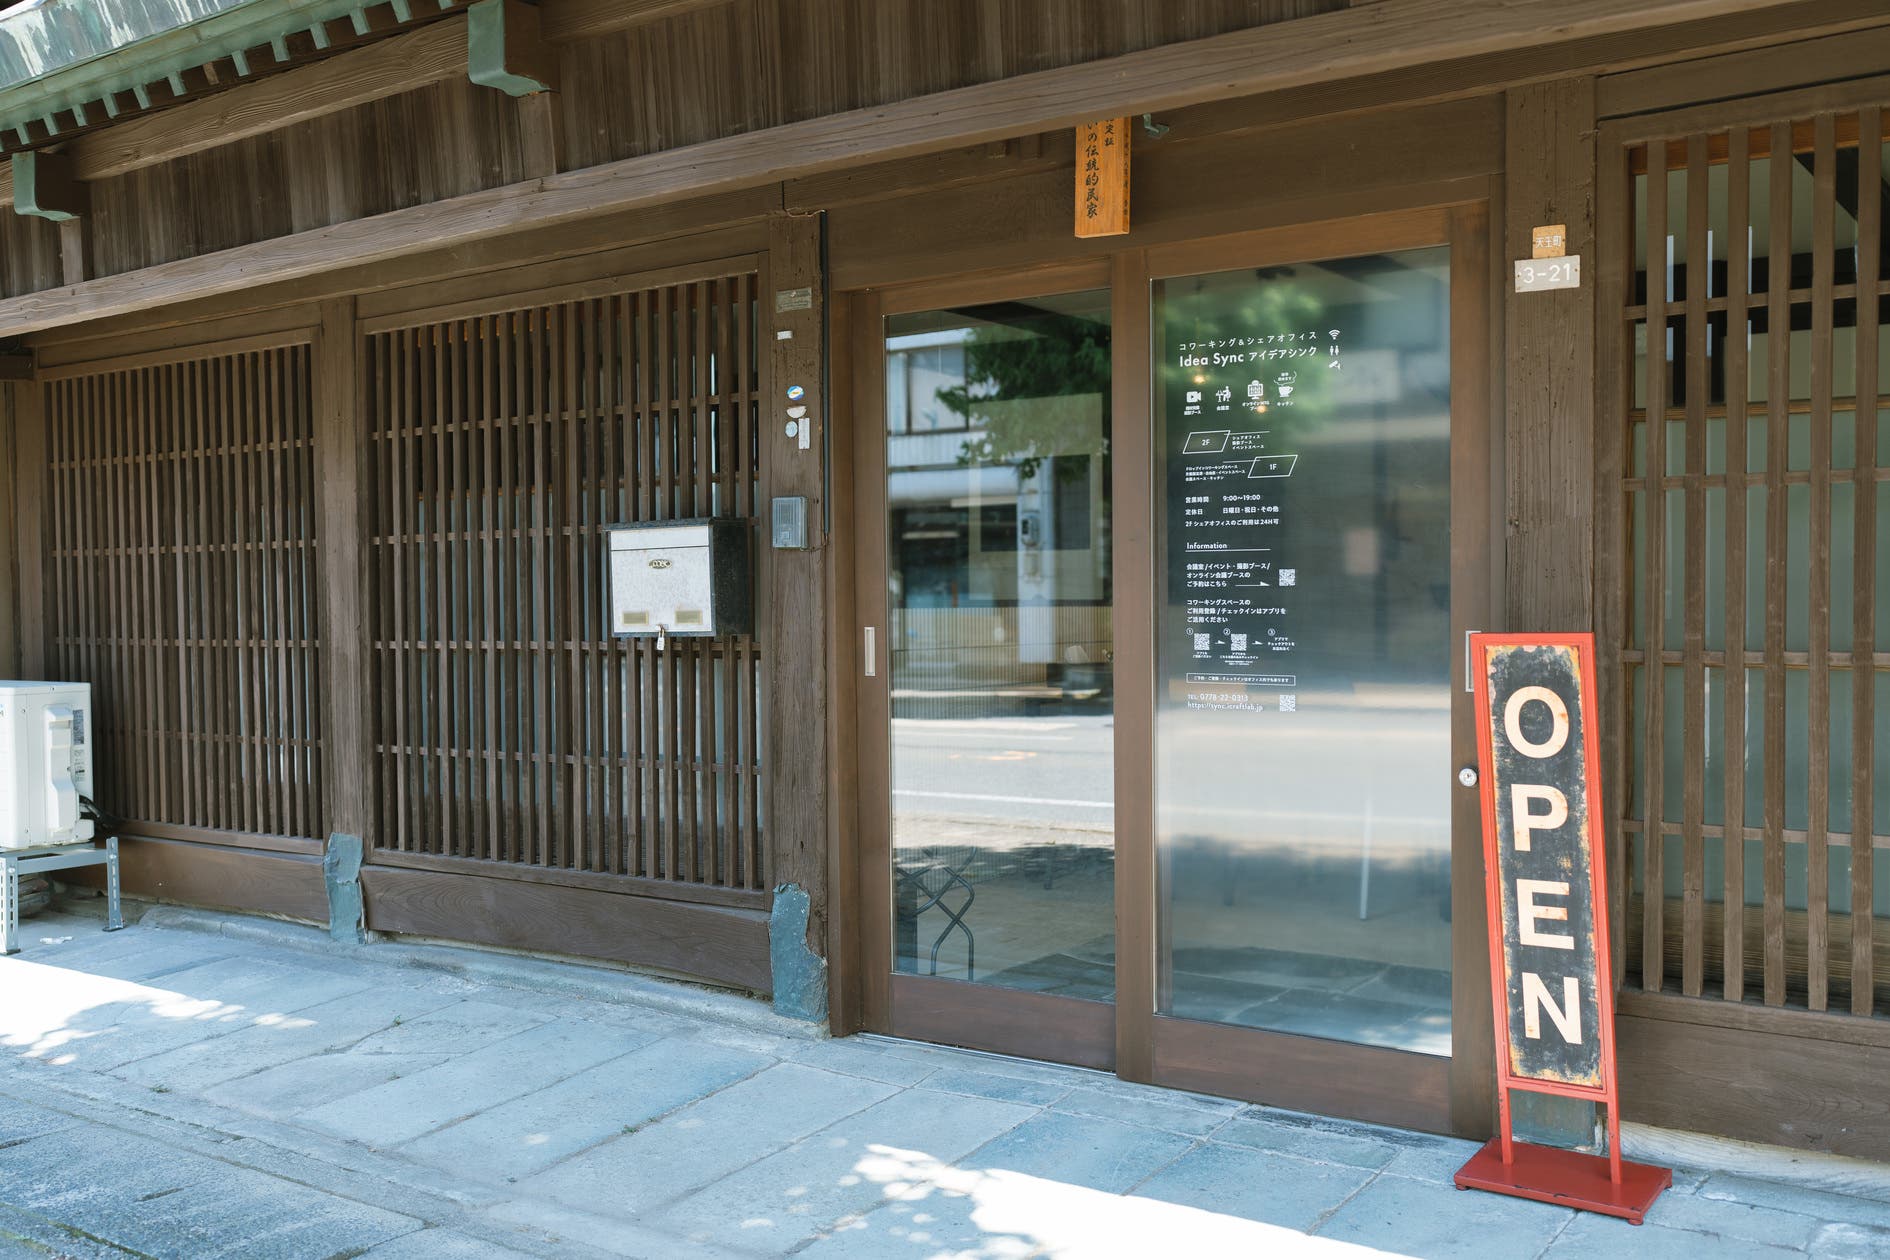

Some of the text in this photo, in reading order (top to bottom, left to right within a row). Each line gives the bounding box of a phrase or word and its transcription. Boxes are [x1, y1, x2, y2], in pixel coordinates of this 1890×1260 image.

[1536, 235, 1562, 248] 天王町
[1523, 263, 1571, 284] 3-21
[1180, 346, 1317, 367] Idea Sync アイデアシンク
[1503, 685, 1583, 1045] OPEN
